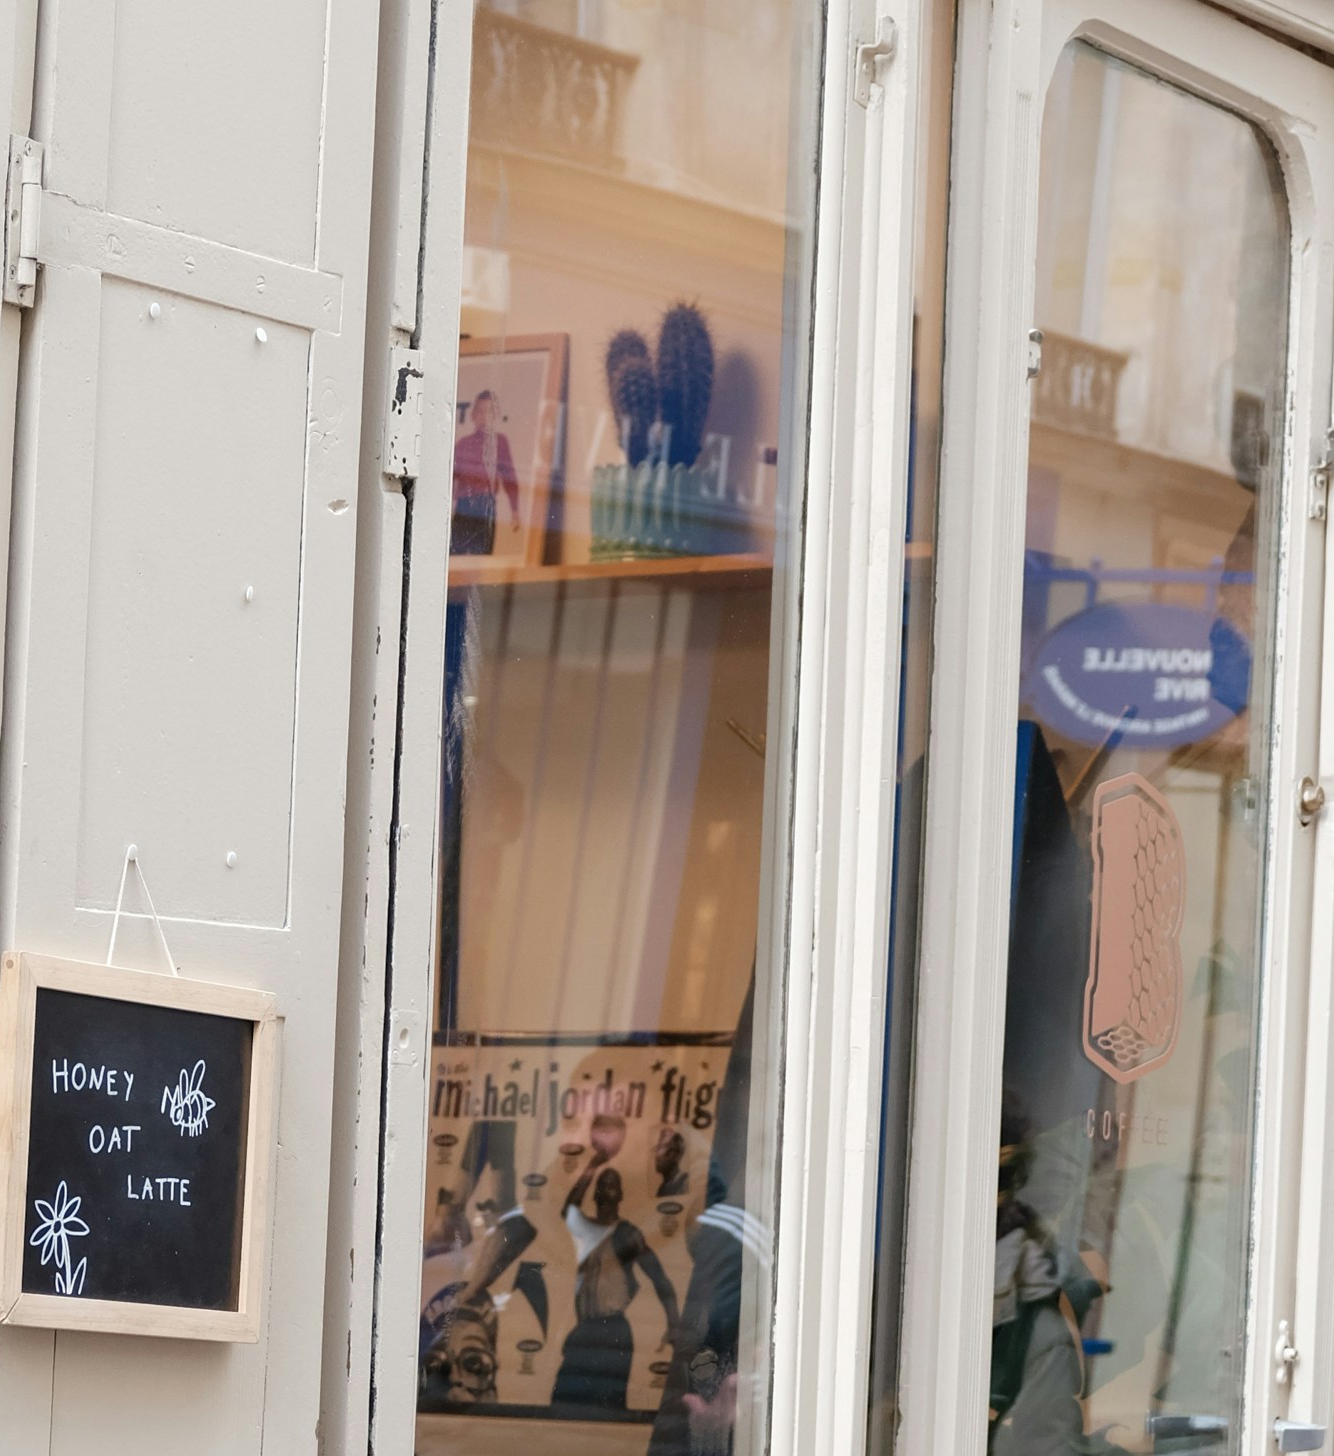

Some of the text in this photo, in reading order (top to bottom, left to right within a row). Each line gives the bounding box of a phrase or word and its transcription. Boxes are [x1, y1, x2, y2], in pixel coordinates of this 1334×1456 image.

[51, 1058, 135, 1102] HONEY
[544, 1061, 648, 1138] jordan
[660, 1065, 717, 1130] flig
[88, 1124, 142, 1154] OAT
[127, 1174, 192, 1207] LATTE
